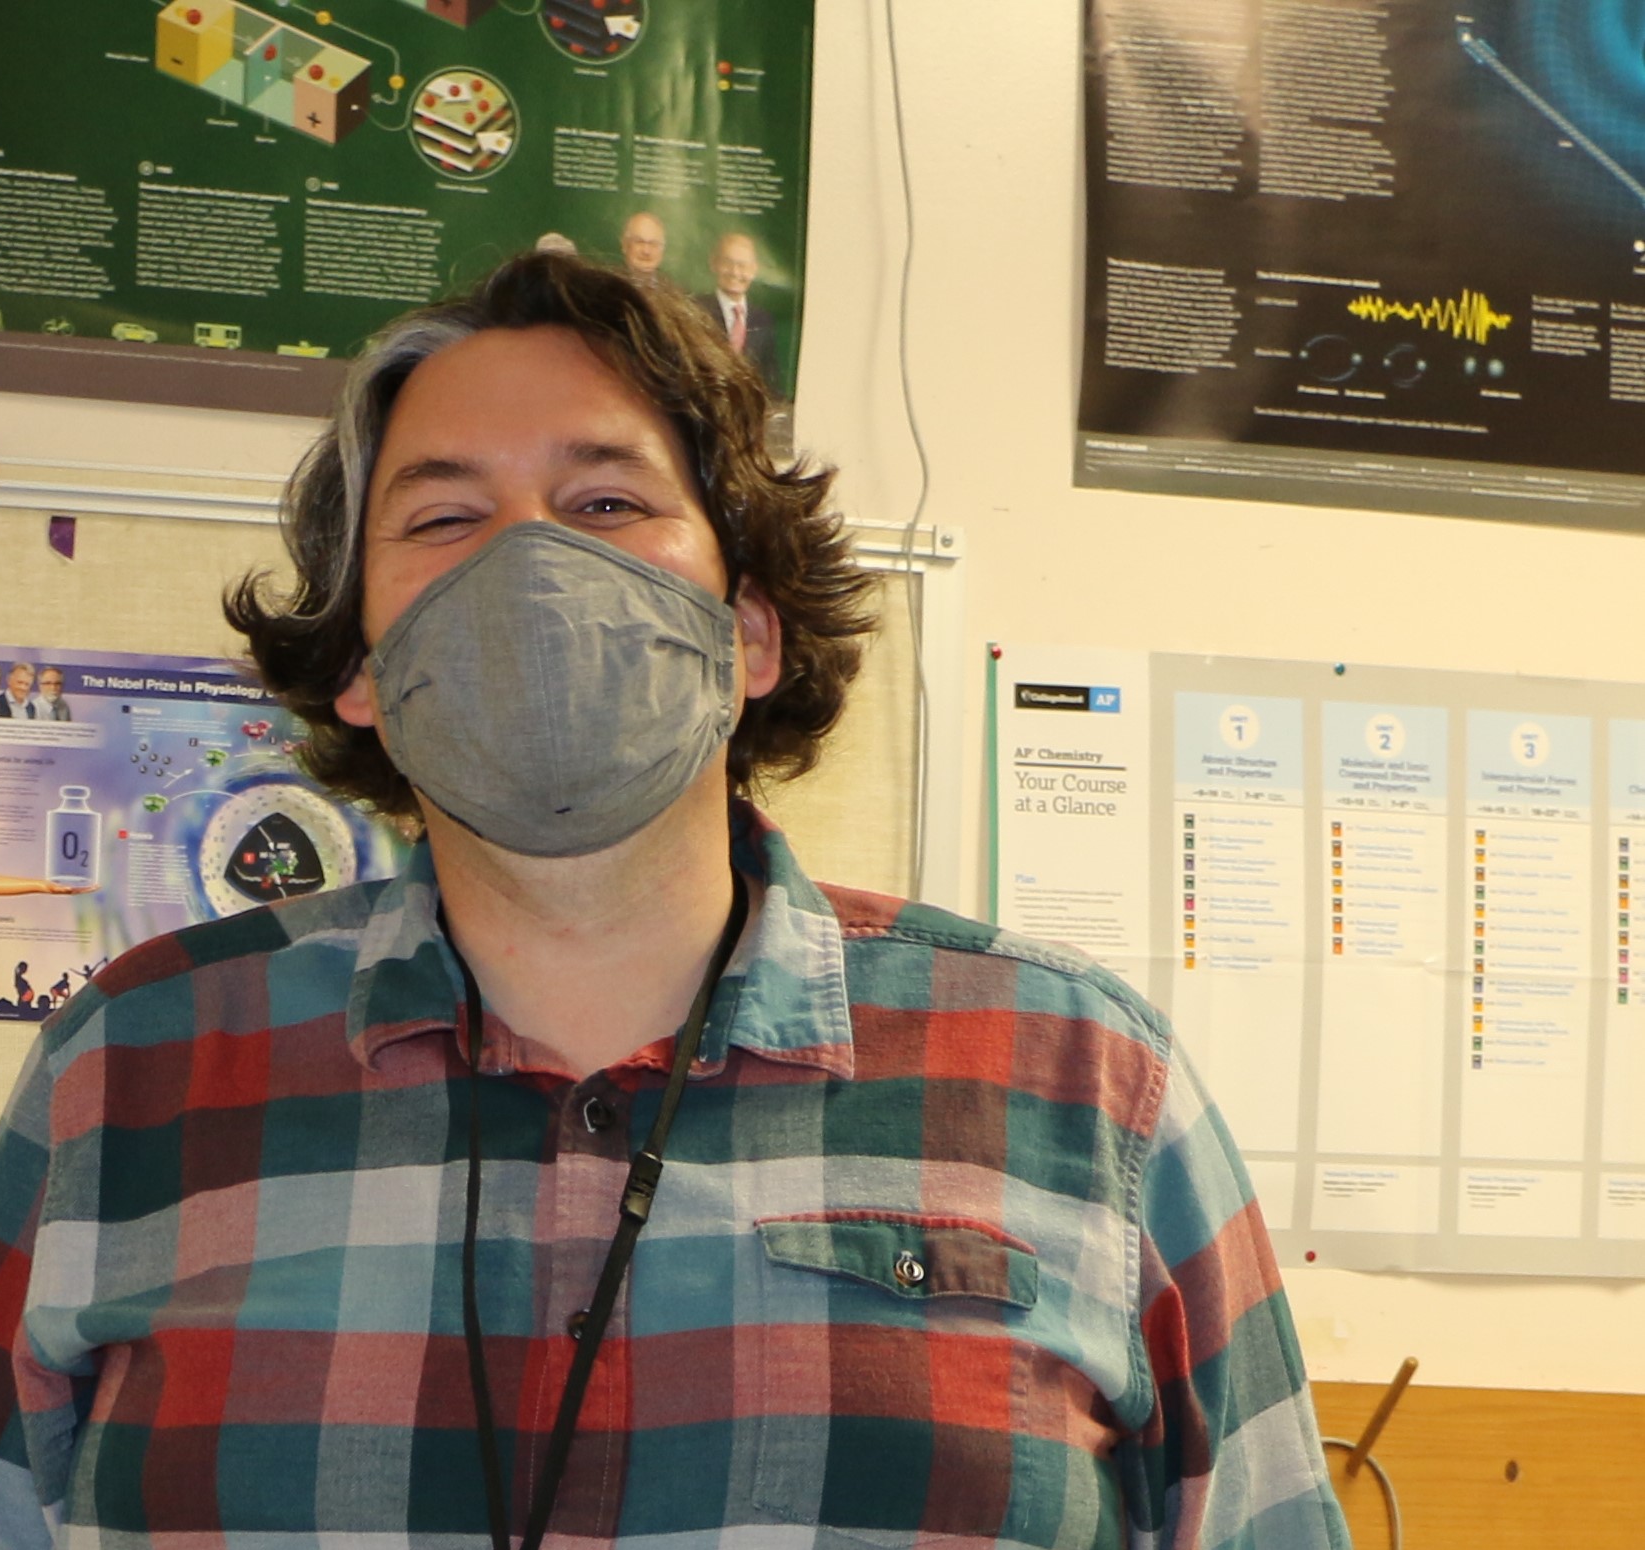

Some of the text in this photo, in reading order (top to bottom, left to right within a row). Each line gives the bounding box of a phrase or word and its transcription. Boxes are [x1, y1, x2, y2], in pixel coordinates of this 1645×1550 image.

[81, 674, 105, 689] The
[107, 676, 144, 691] Nobel
[146, 678, 177, 692] Prize
[179, 680, 193, 693] in
[195, 681, 264, 700] Physiology
[1234, 725, 1243, 741] 1
[1379, 734, 1391, 750] 2
[1524, 742, 1536, 759] 3
[1037, 748, 1104, 764] Chemistry
[1014, 771, 1127, 794] Your Course
[1014, 796, 1117, 817] at a Glance
